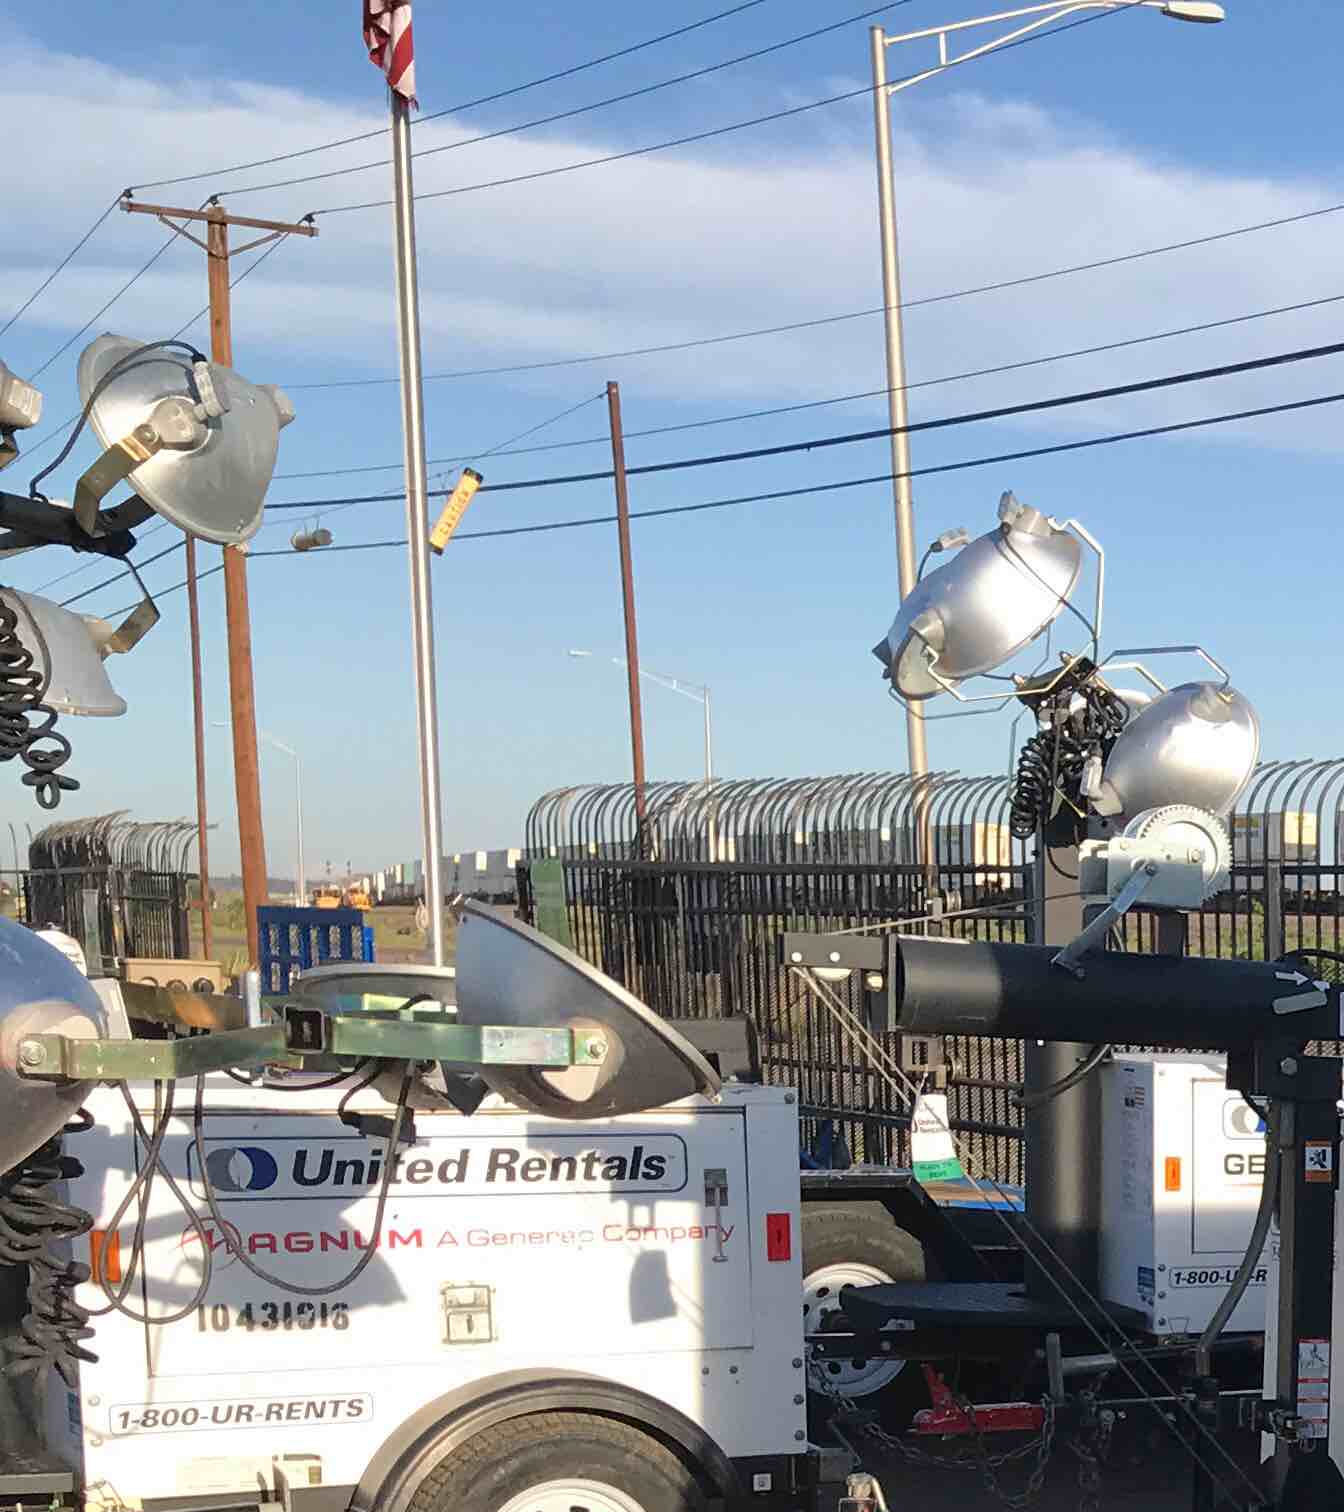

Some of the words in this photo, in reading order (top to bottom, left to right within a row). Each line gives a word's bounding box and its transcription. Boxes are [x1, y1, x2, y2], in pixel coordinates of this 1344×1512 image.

[292, 1147, 470, 1187] United
[485, 1145, 668, 1184] Rentals
[601, 1222, 736, 1244] Company
[118, 1397, 366, 1430] 1-800-UR-RENTS
